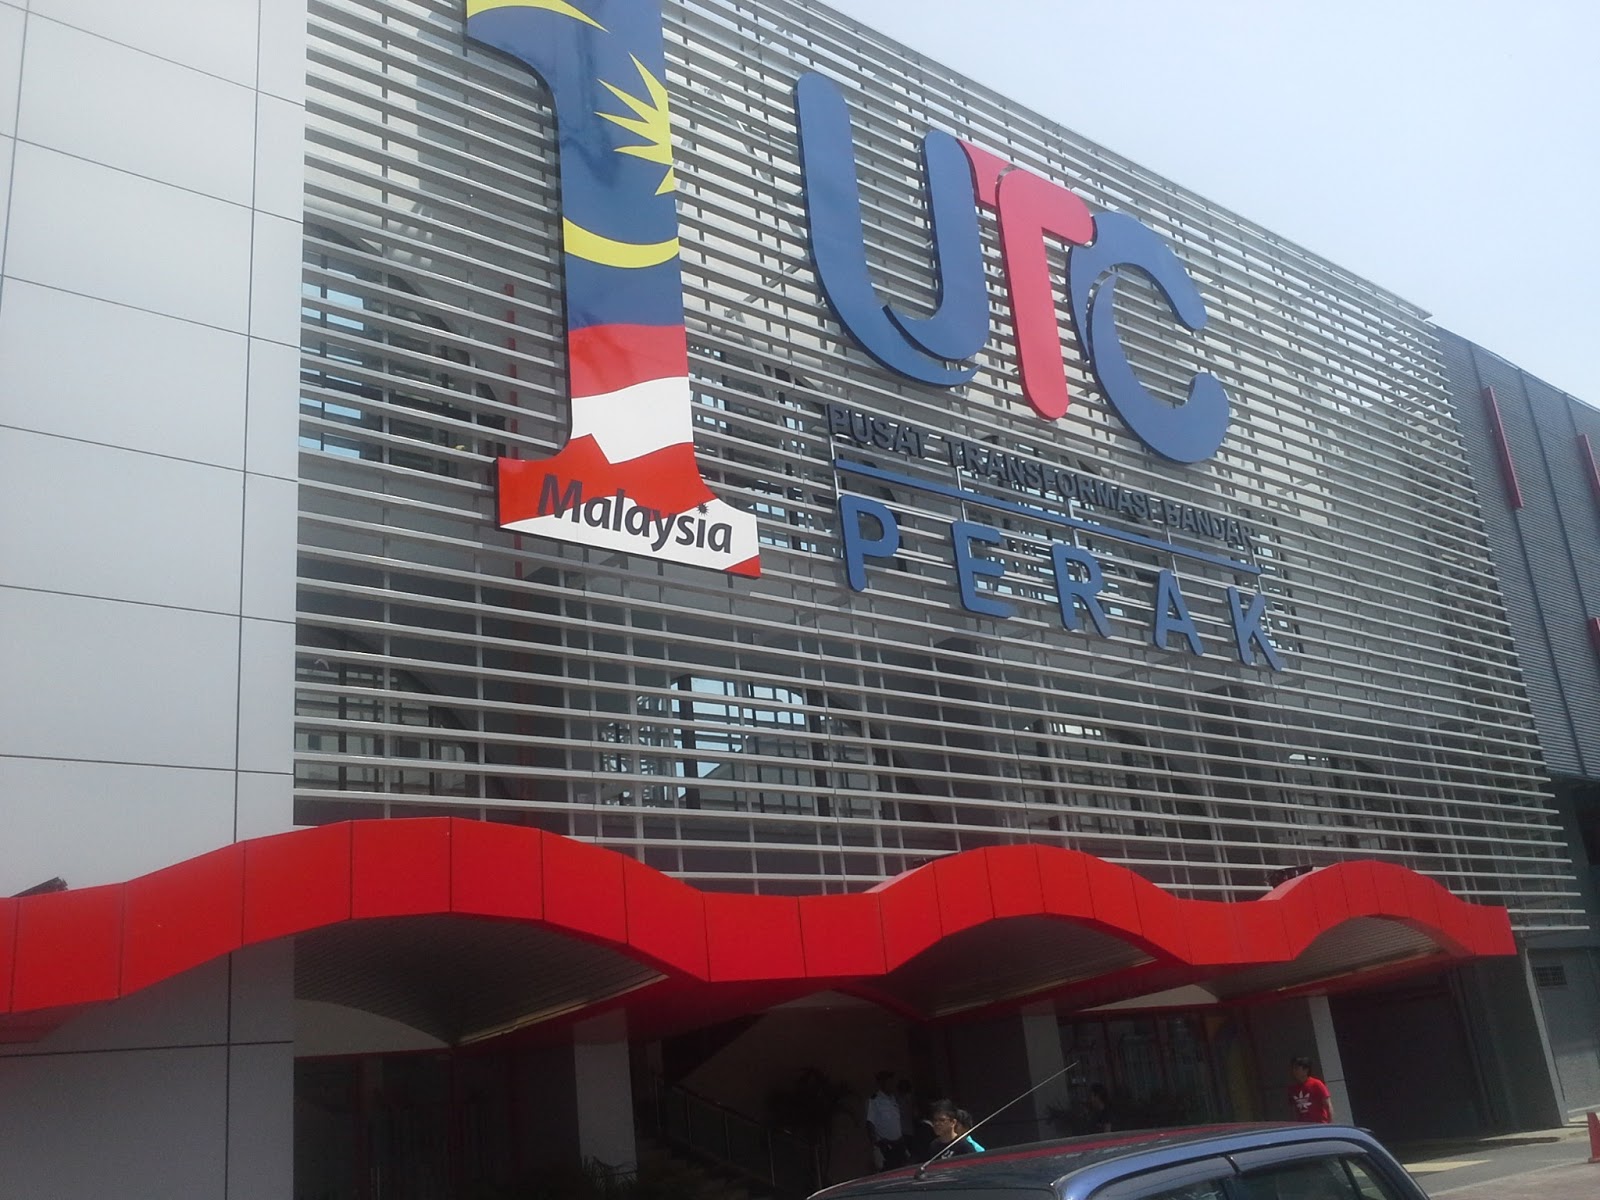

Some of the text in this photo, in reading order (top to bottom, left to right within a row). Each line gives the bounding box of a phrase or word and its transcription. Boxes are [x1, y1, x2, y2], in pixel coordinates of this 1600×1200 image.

[793, 72, 1230, 464] UTC
[538, 474, 732, 552] Malaysia
[826, 403, 1254, 549] PUSAT TRANSFORMASI BANDAR
[840, 494, 1284, 672] PERAK
